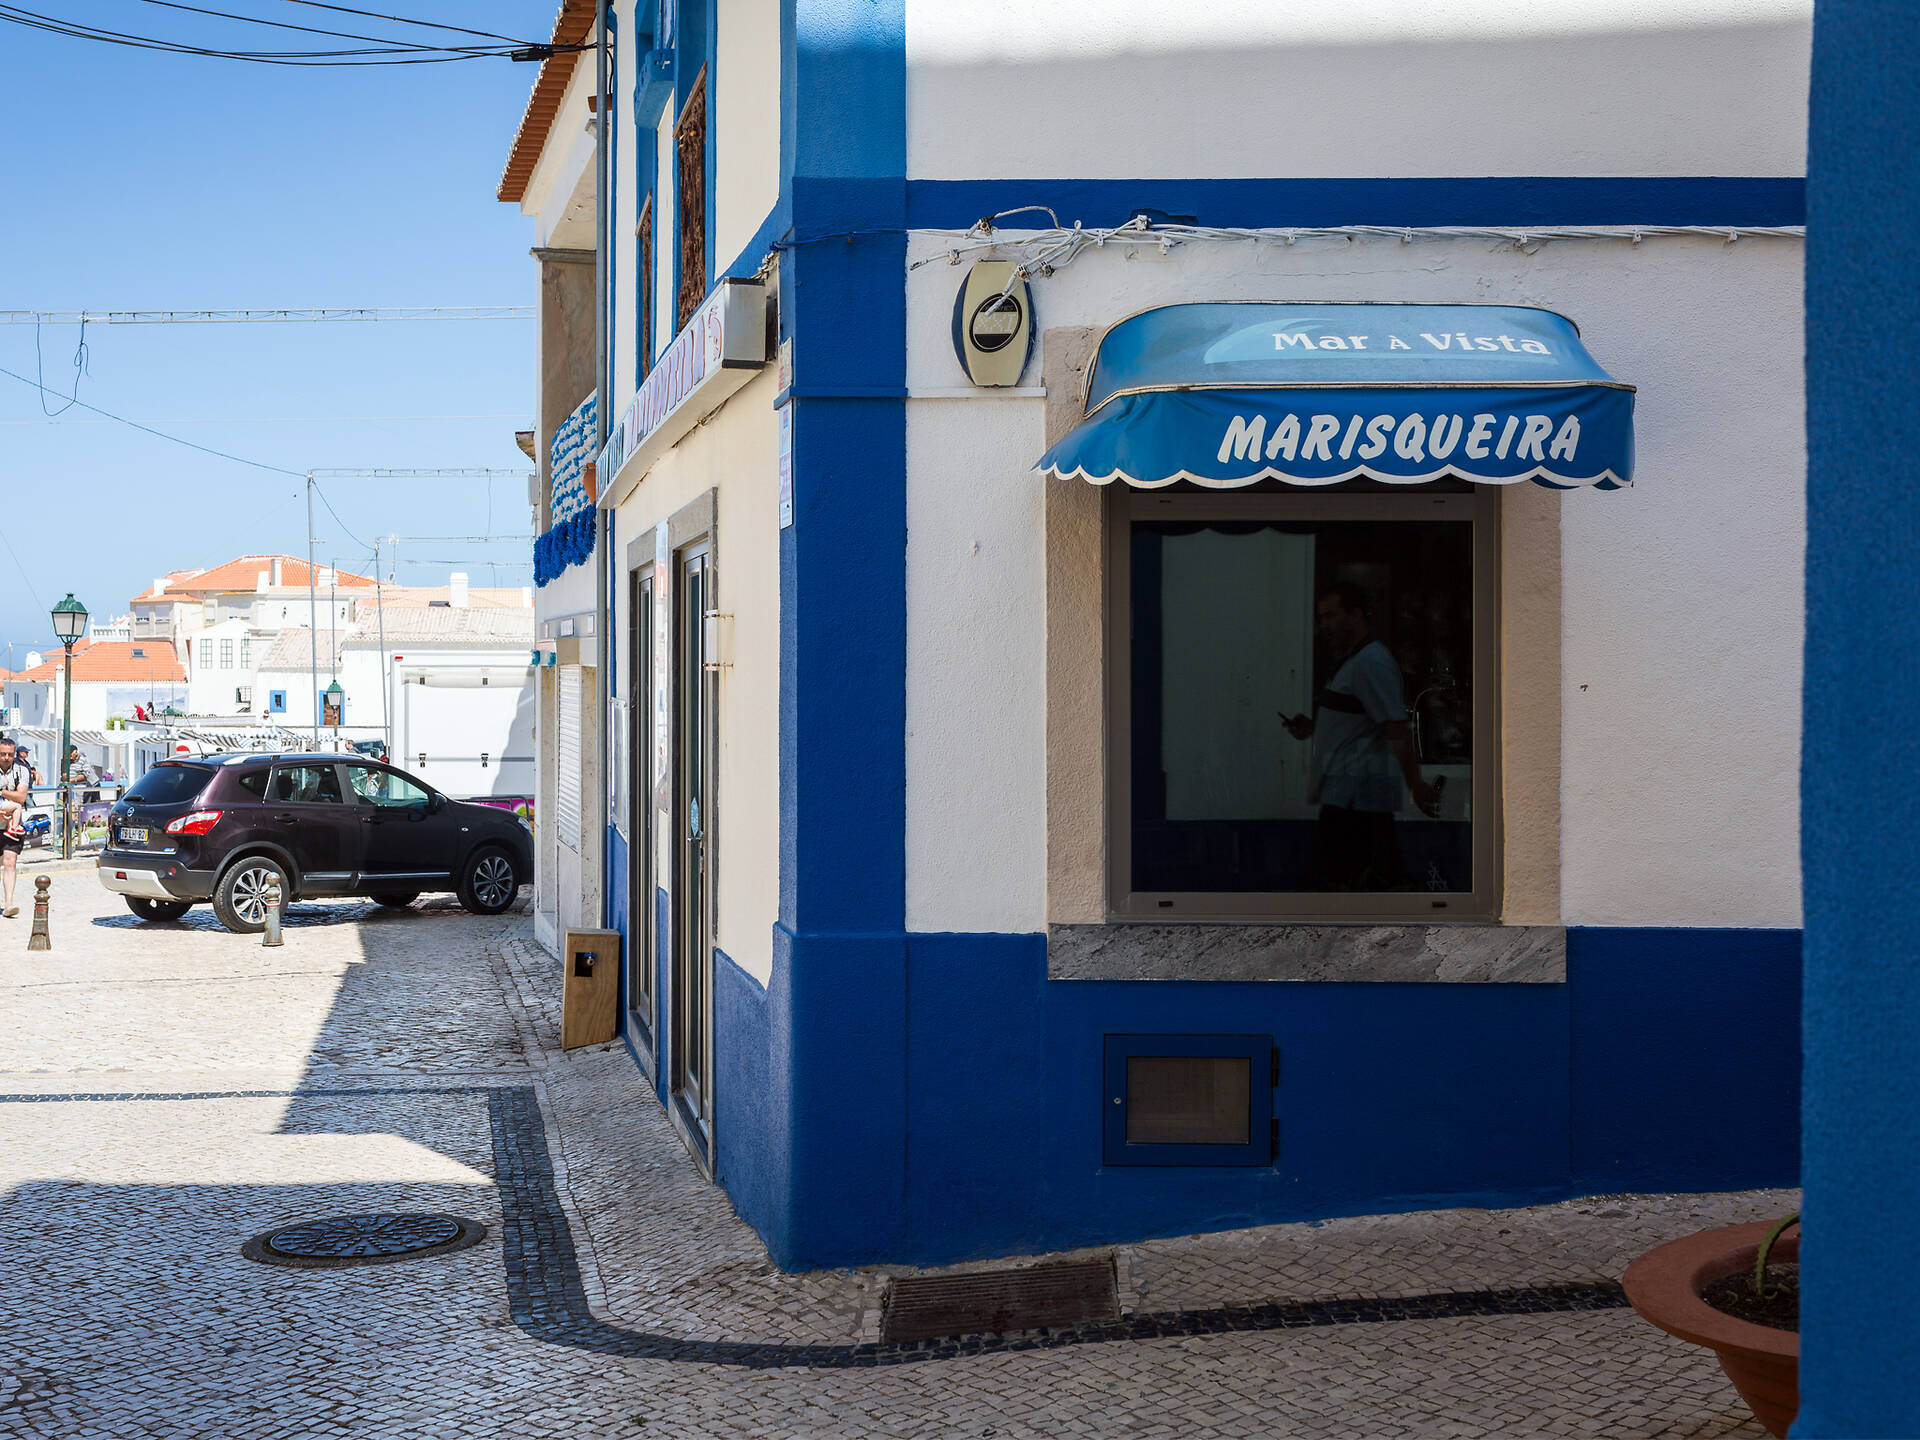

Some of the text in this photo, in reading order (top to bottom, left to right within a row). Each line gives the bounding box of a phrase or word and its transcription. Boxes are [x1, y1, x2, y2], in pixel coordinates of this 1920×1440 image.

[1272, 333, 1368, 350] Mar
[1420, 332, 1551, 355] Vista
[1217, 412, 1581, 462] MARISQUEIRA
